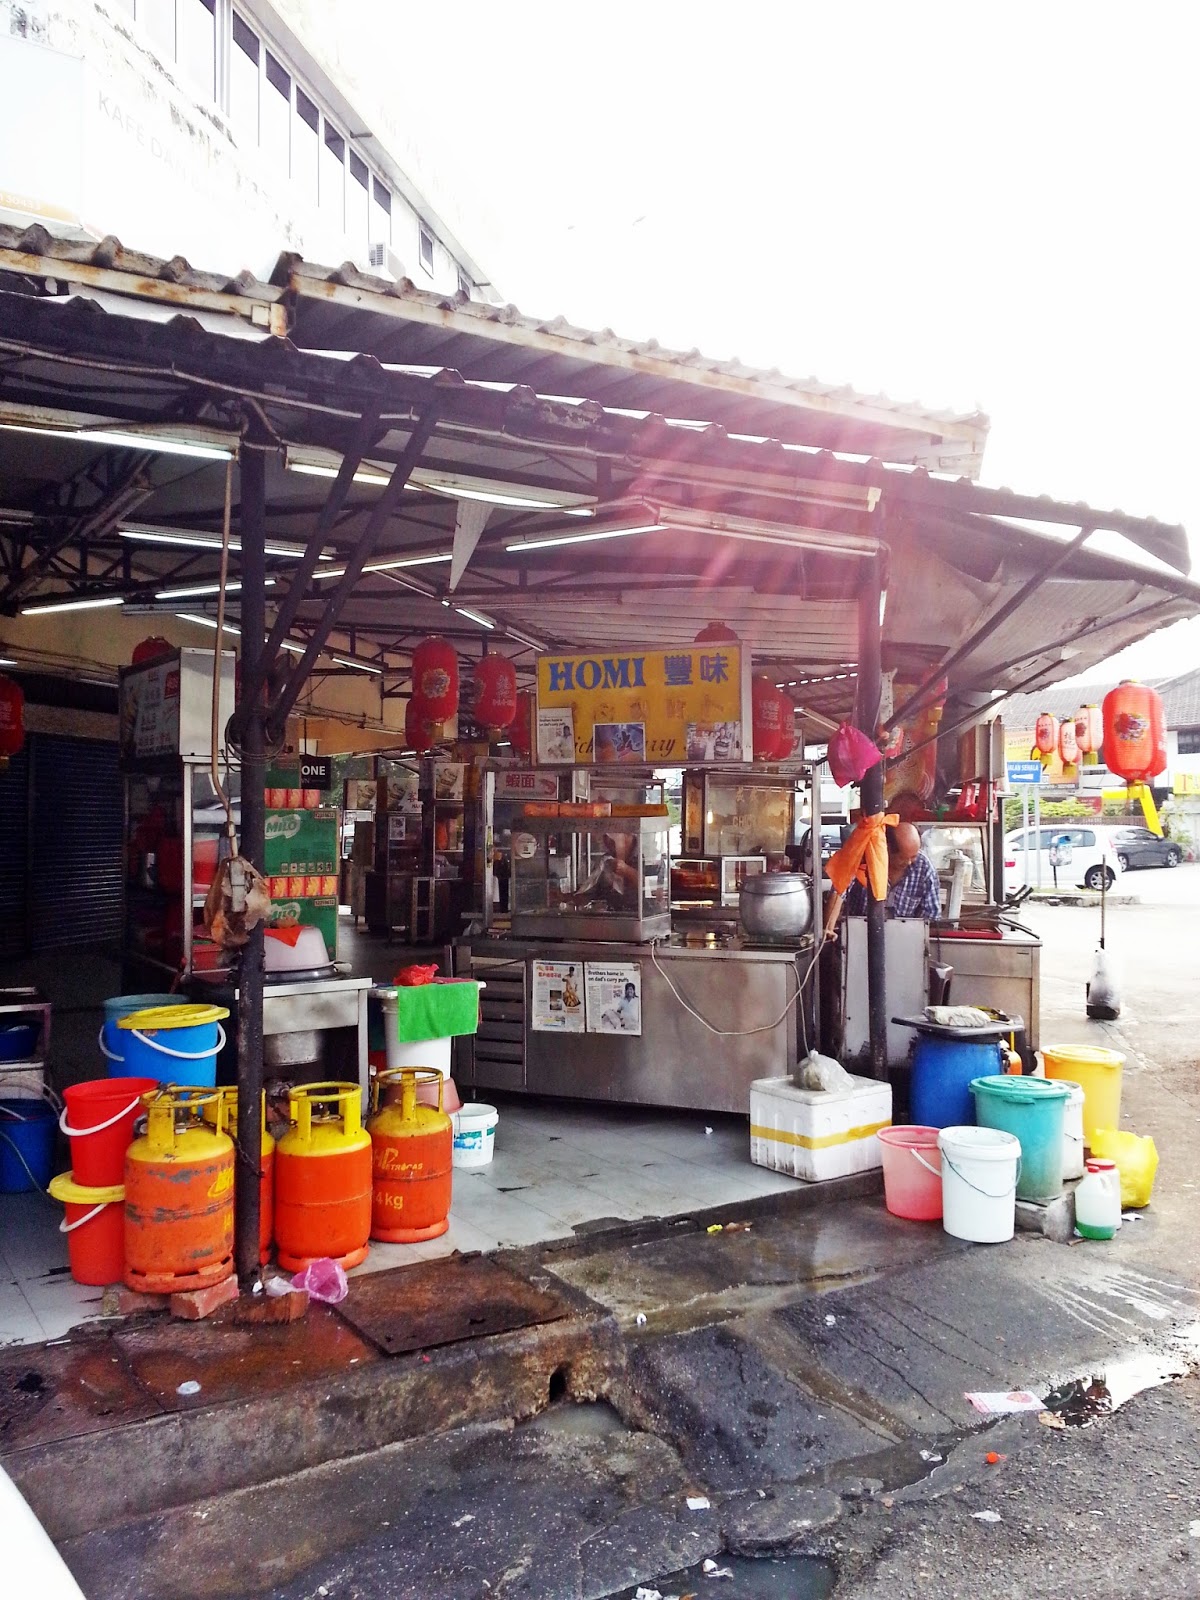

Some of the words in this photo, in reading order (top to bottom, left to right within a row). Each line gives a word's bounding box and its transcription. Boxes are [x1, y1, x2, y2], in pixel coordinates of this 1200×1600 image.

[548, 657, 646, 691] HOMI
[664, 653, 729, 686] 豐味
[301, 765, 326, 776] ONE
[505, 773, 536, 788] 蝦面
[265, 820, 298, 833] MILO
